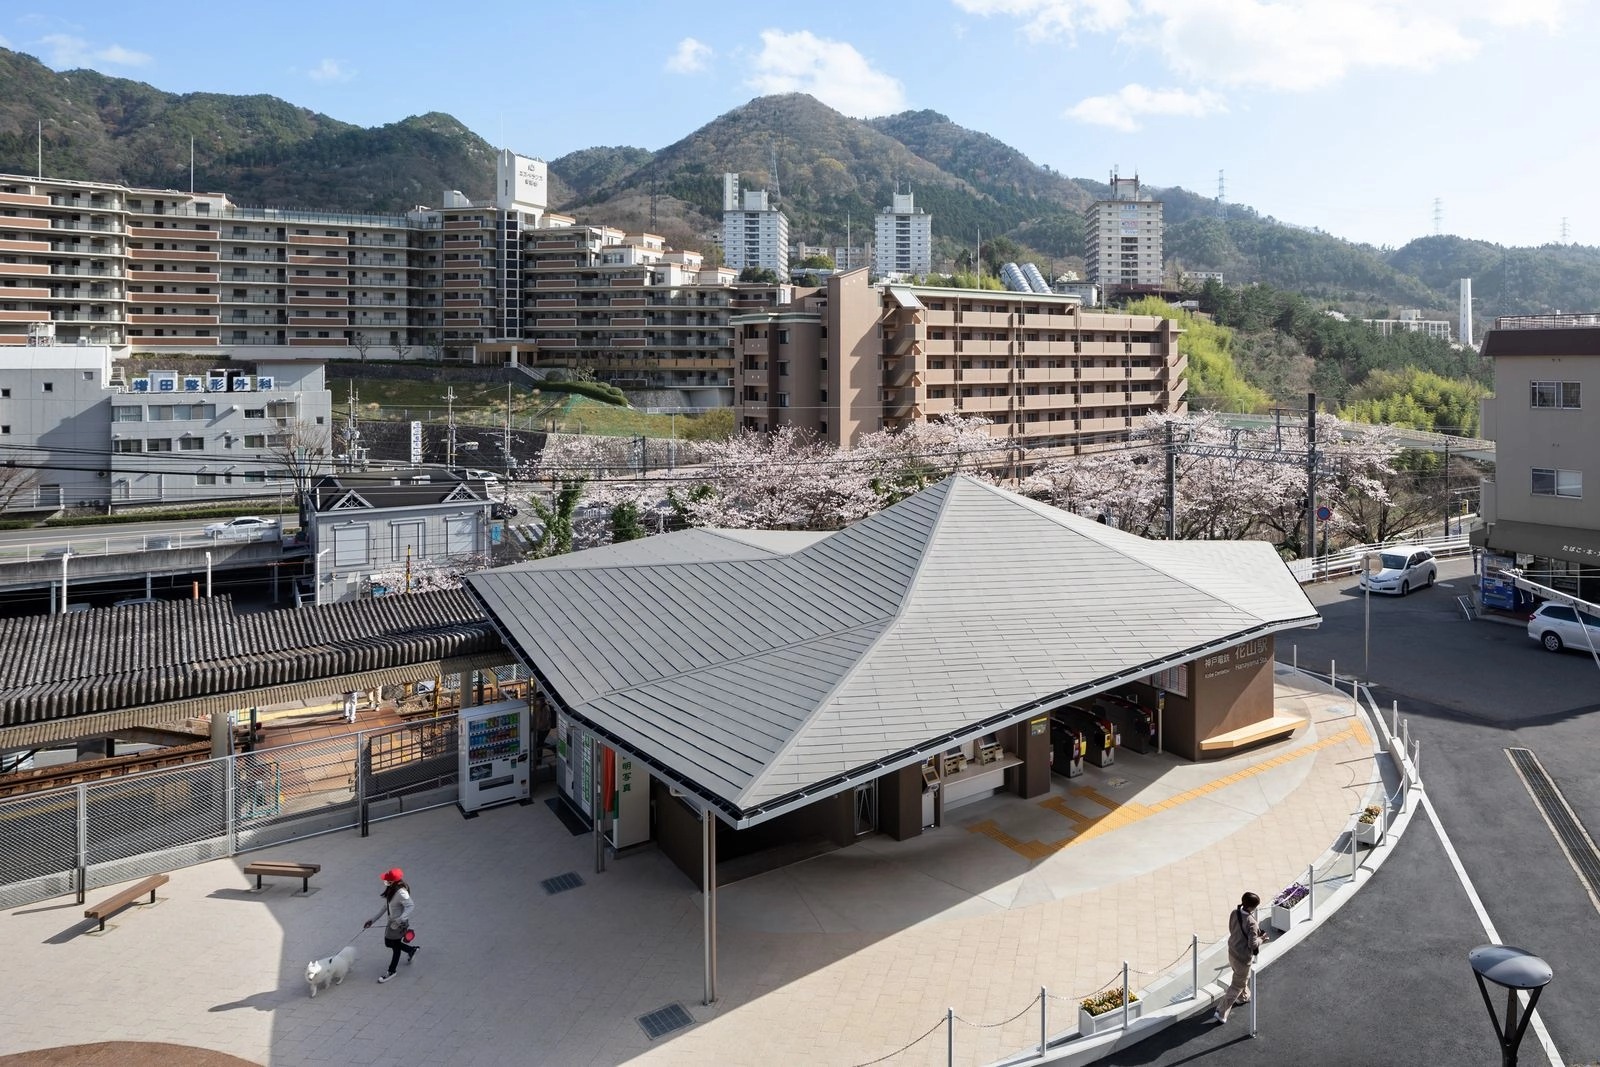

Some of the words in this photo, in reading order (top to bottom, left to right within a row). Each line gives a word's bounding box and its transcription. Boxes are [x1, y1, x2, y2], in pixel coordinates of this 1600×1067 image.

[133, 376, 273, 392] 増田整形外科
[1204, 653, 1230, 668] 神戸電鉄
[1235, 637, 1268, 660] 花山駅
[622, 756, 632, 793] 明写真
